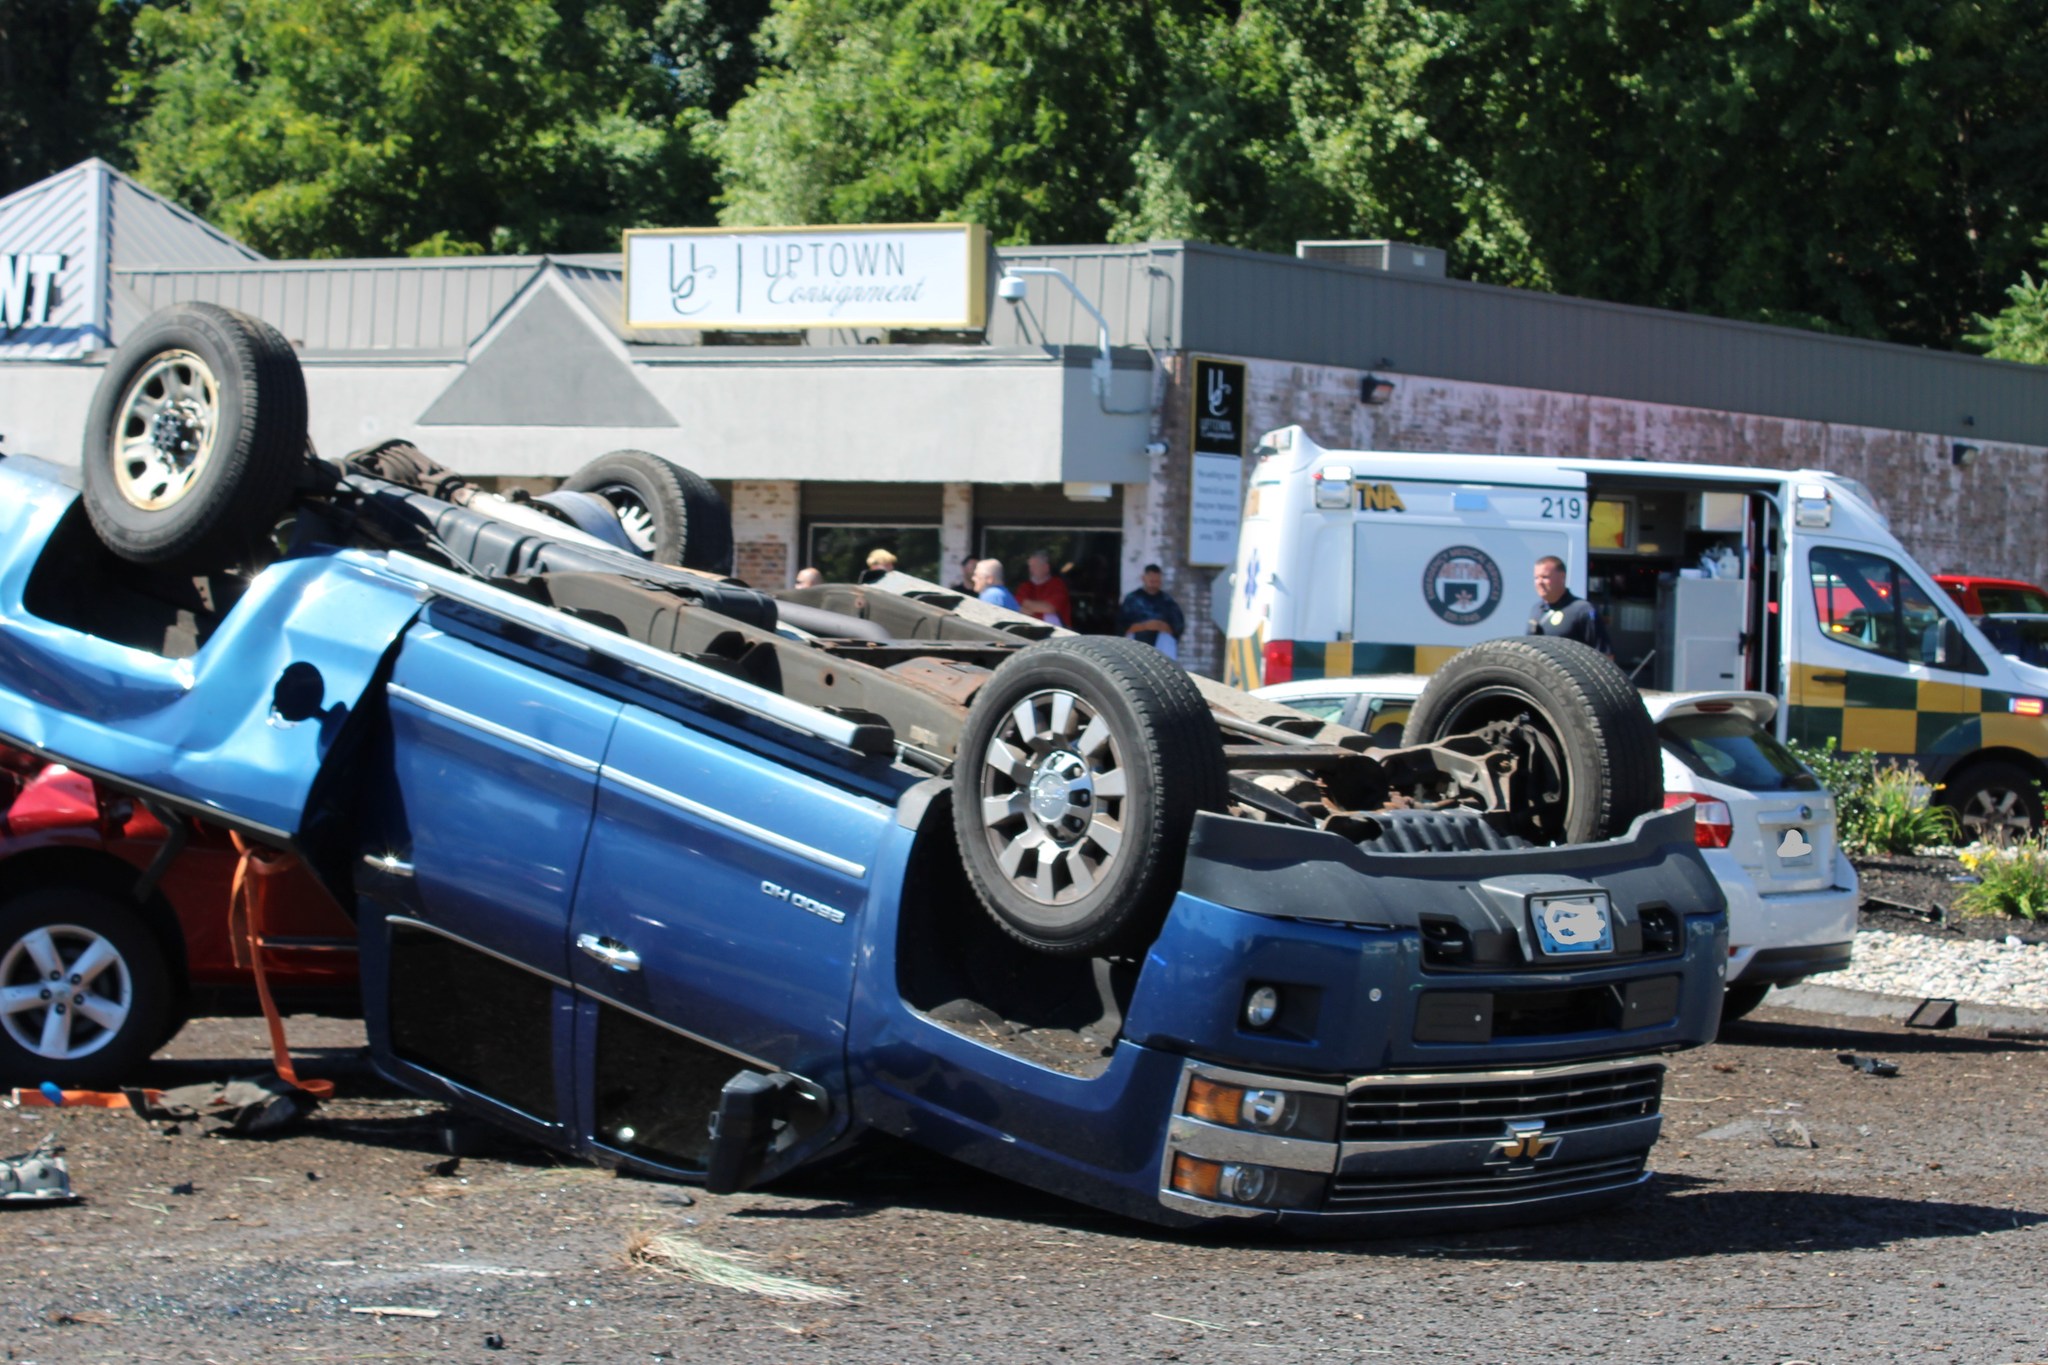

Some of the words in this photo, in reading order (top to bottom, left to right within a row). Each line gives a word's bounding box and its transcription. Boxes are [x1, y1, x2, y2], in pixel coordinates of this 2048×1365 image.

[762, 242, 904, 278] UPTOWN
[767, 271, 927, 317] Consignment
[1541, 496, 1581, 519] 219
[761, 880, 791, 903] HD
